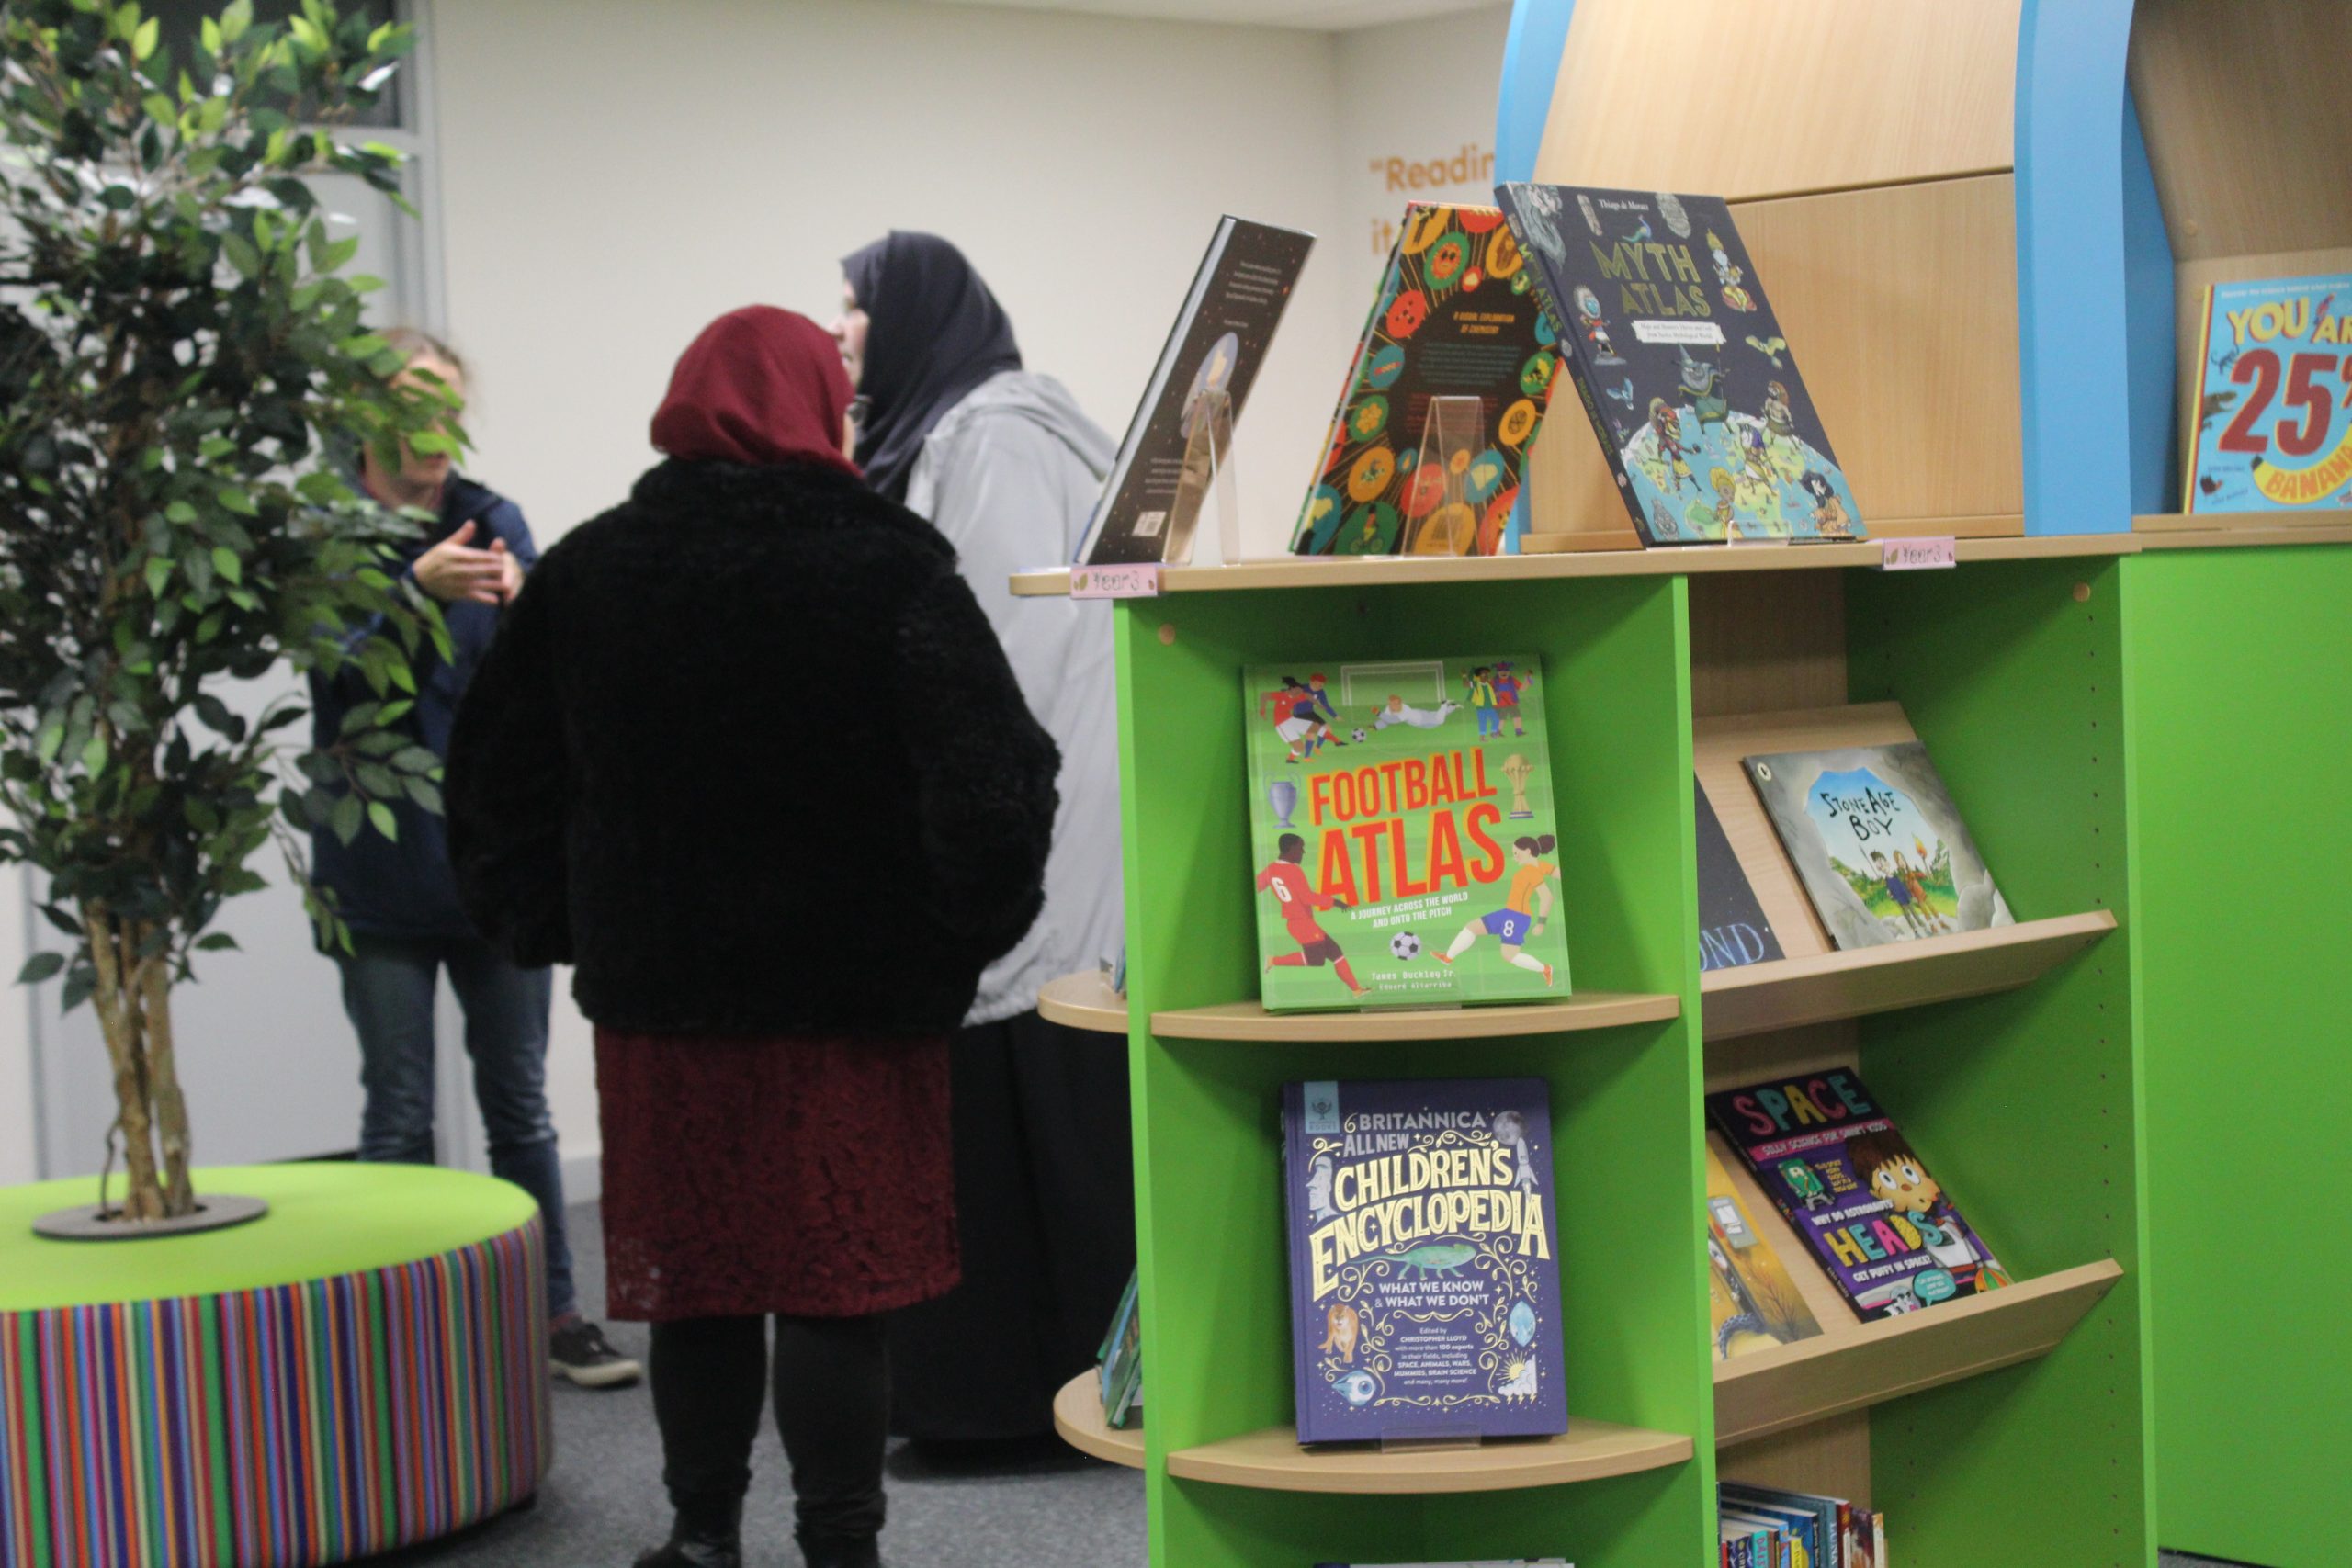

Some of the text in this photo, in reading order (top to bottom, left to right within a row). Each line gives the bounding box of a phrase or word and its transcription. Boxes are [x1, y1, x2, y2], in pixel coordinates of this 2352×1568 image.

[1589, 239, 1702, 283] MYTH
[1621, 282, 1712, 318] ATLAS
[2226, 295, 2311, 345] YOU
[2218, 348, 2352, 457] 25
[1306, 746, 1498, 826] FOOTBALL
[1820, 786, 1901, 818] STONE AGE
[1849, 814, 1893, 841] BOY
[1315, 801, 1506, 912] ATLAS
[1270, 875, 1293, 903] 6
[1351, 891, 1468, 921] A JOURNEY ACROSS THE WORLD
[1373, 906, 1452, 930] AND ONTO THE PITCH
[1502, 919, 1515, 938] 8
[1733, 1074, 1871, 1136] SPACE
[1360, 1111, 1487, 1131] BRITANNICA
[1343, 1132, 1409, 1157] ALL NEW
[1334, 1141, 1513, 1212] CHILDREN'S
[1811, 1213, 1832, 1226] WHY
[1831, 1210, 1845, 1222] DO
[1308, 1190, 1551, 1302] ENCYCLOPEDIA
[1823, 1210, 1943, 1268] HEADS
[1853, 1269, 1870, 1283] GET
[1894, 1260, 1905, 1272] IN
[1374, 1294, 1490, 1308] & WHAT WE DON'T
[1378, 1280, 1485, 1294] WHAT WE KNOW
[1440, 1327, 1447, 1336] by
[1449, 1368, 1477, 1376] SCIENCE
